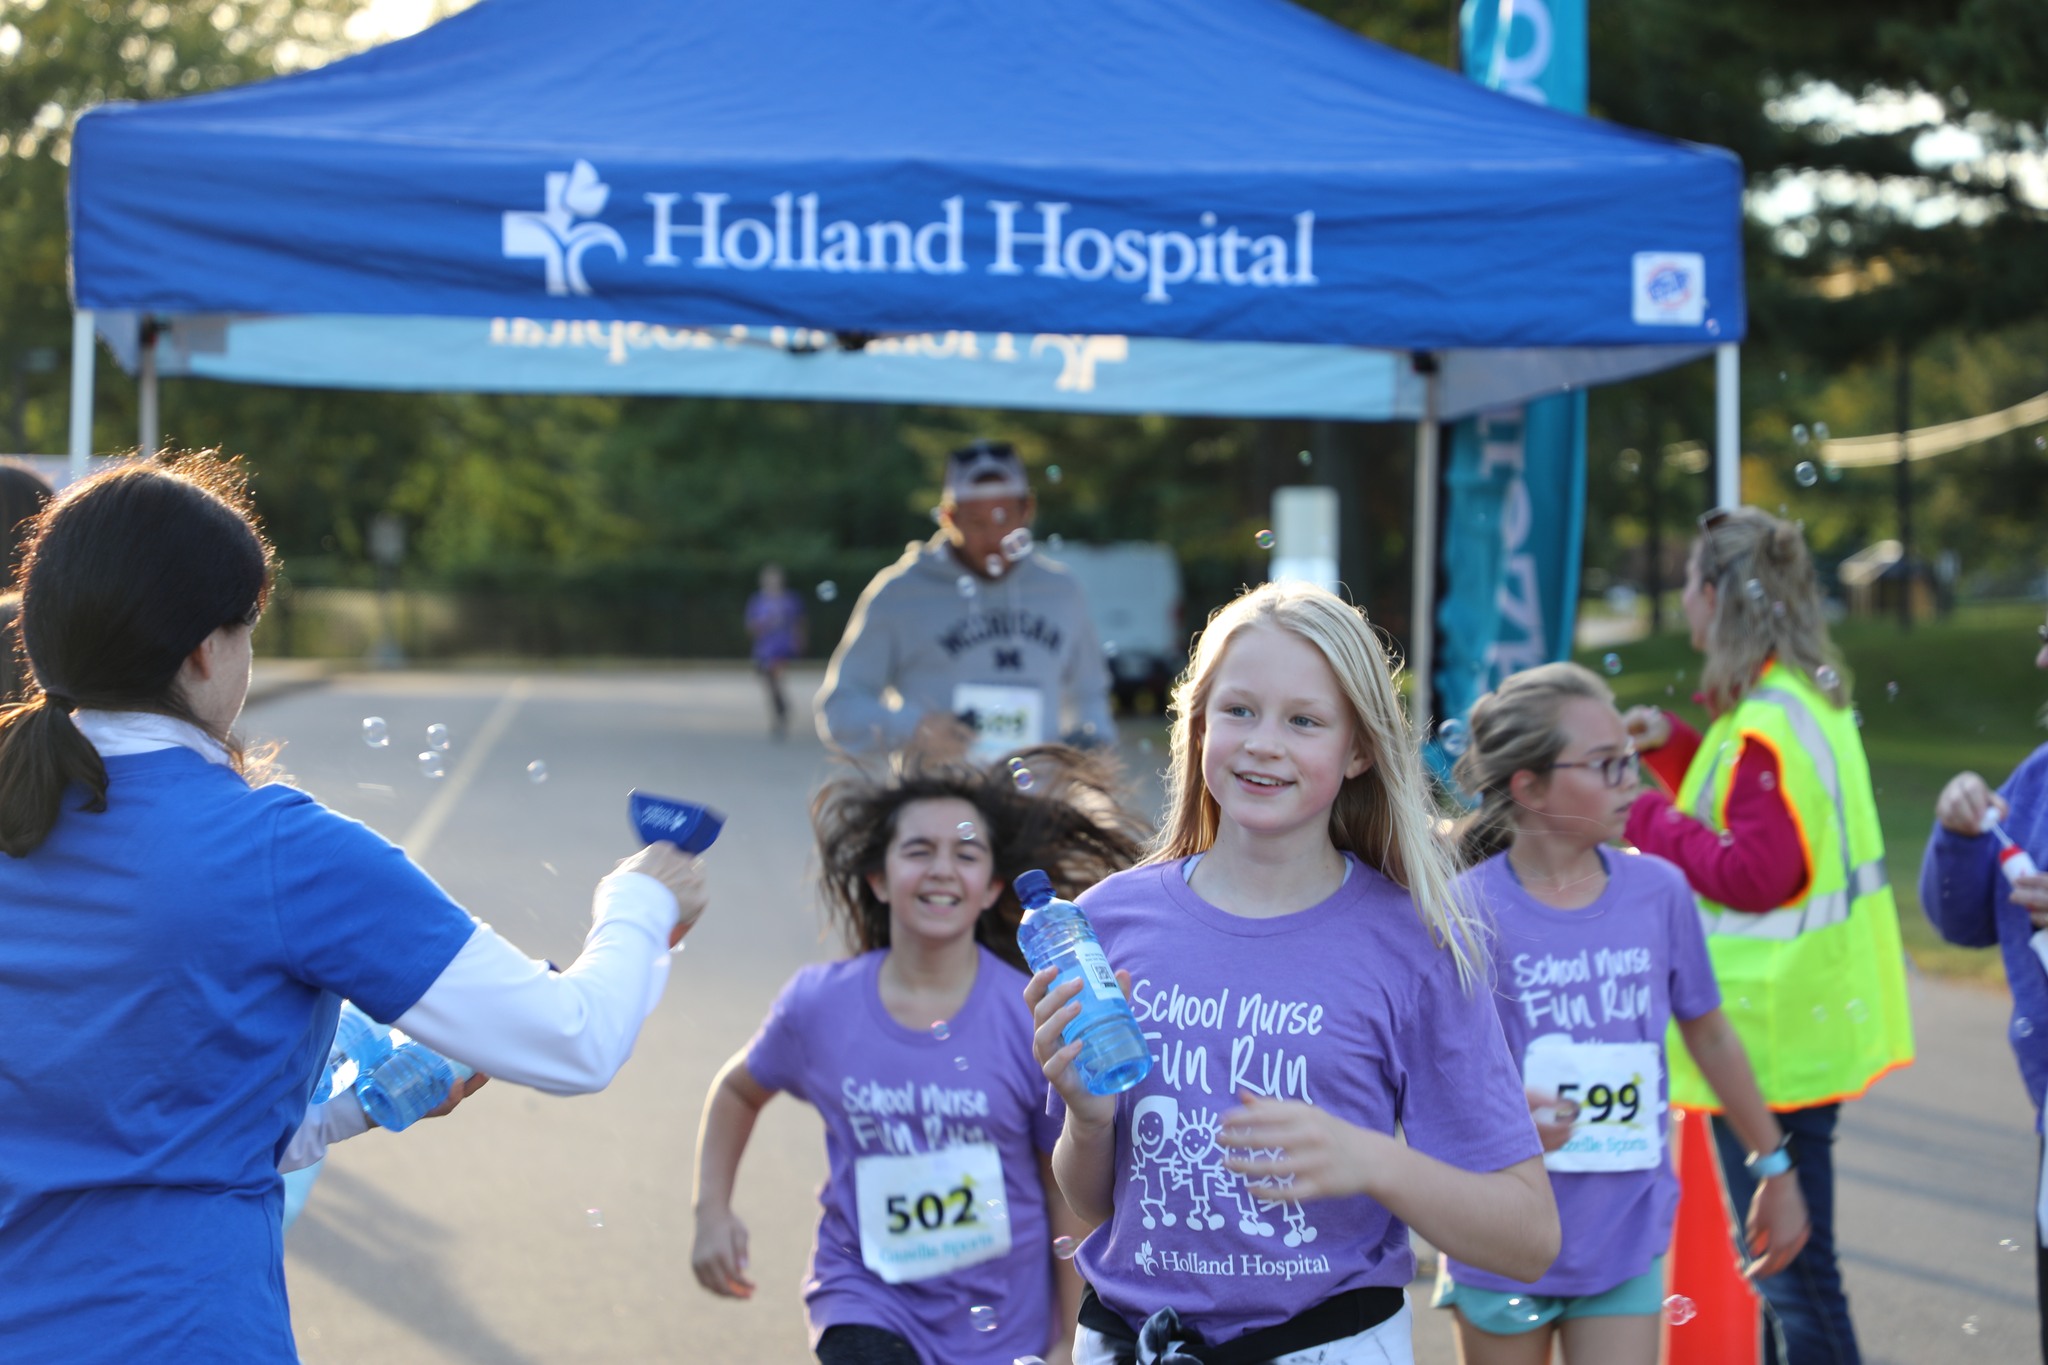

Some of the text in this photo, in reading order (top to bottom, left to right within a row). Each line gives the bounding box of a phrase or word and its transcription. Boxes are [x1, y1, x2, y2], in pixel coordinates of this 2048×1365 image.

[645, 192, 1318, 304] Holland Hospital
[1513, 949, 1590, 988] School
[1131, 979, 1229, 1030] School
[1519, 978, 1652, 1031] Fun Run
[1229, 1035, 1314, 1106] Run
[841, 1076, 916, 1118] School
[1555, 1083, 1640, 1124] 599
[886, 1185, 979, 1234] 502
[1160, 1250, 1331, 1281] Holland Hospital
